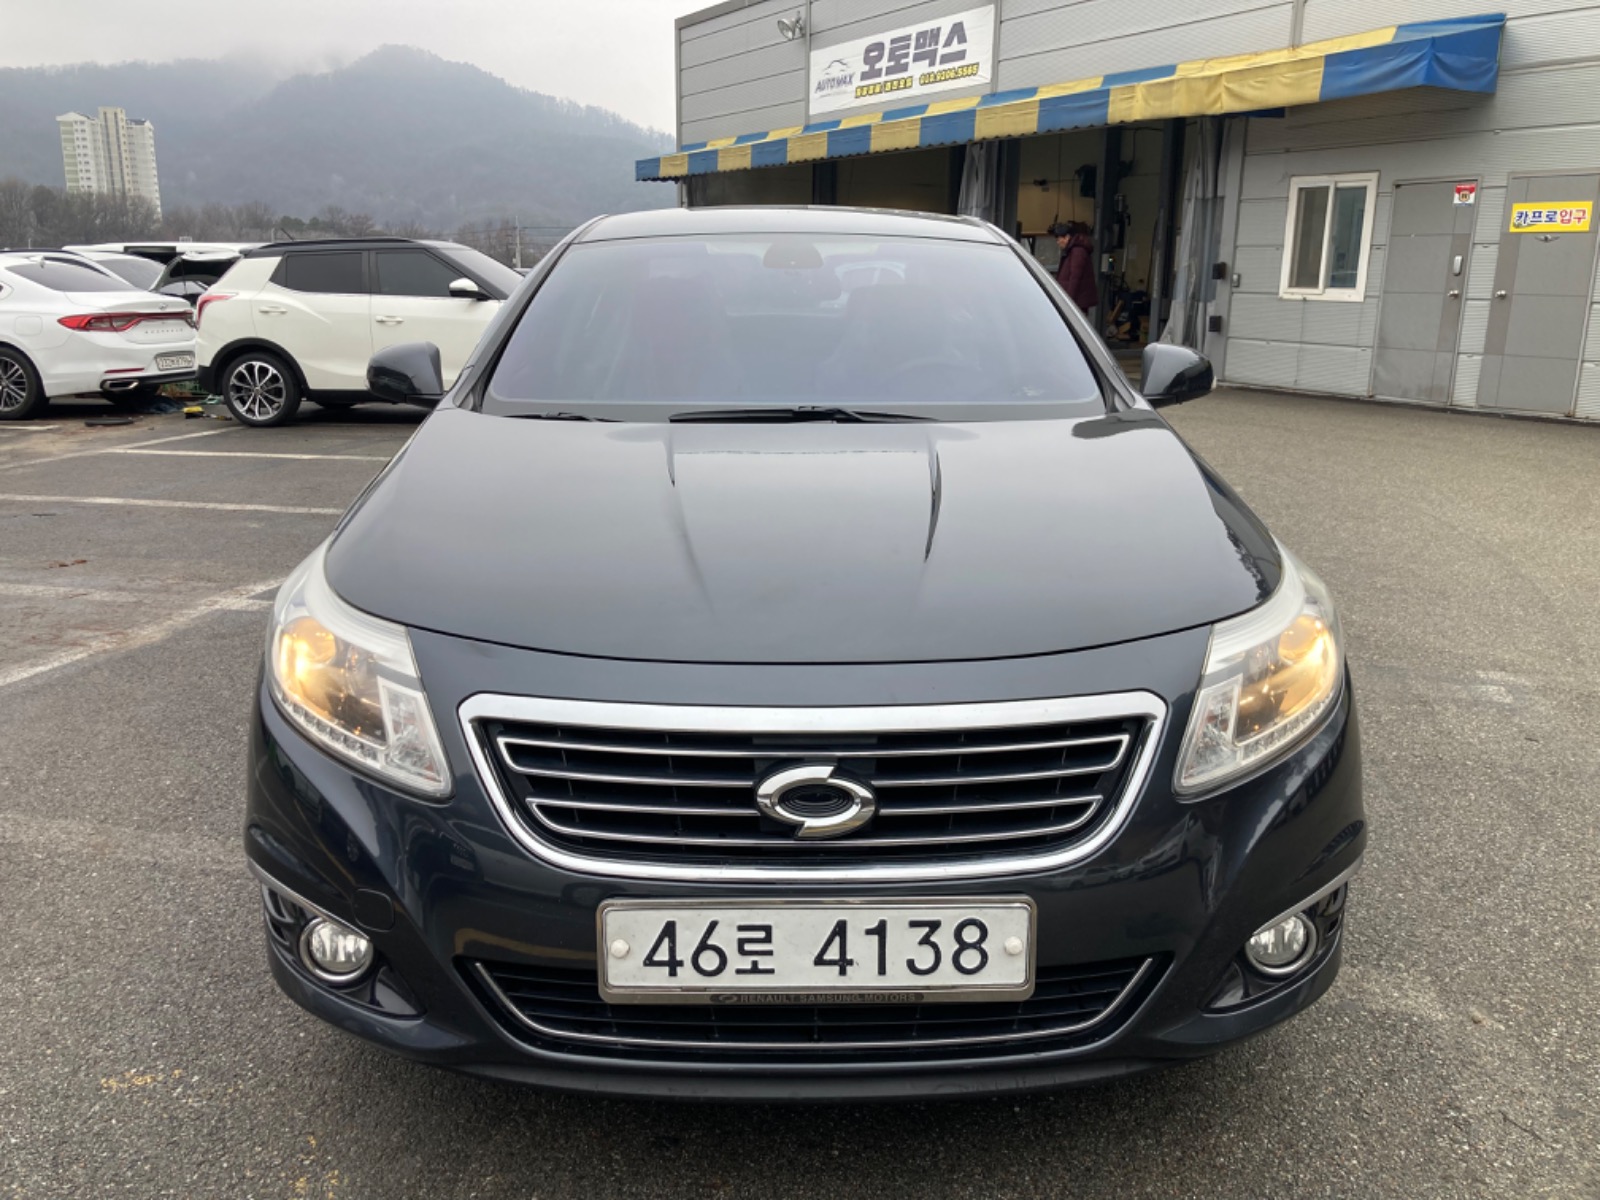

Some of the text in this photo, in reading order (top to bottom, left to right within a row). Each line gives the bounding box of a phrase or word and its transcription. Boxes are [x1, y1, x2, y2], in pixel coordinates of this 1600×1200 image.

[861, 21, 967, 80] 오토맥스
[815, 72, 855, 94] AUTOMAX
[1515, 209, 1587, 224] 카프로입구
[642, 917, 989, 977] 46로 4138
[740, 993, 916, 1003] RENAULT SAMSUNG MOTORS
